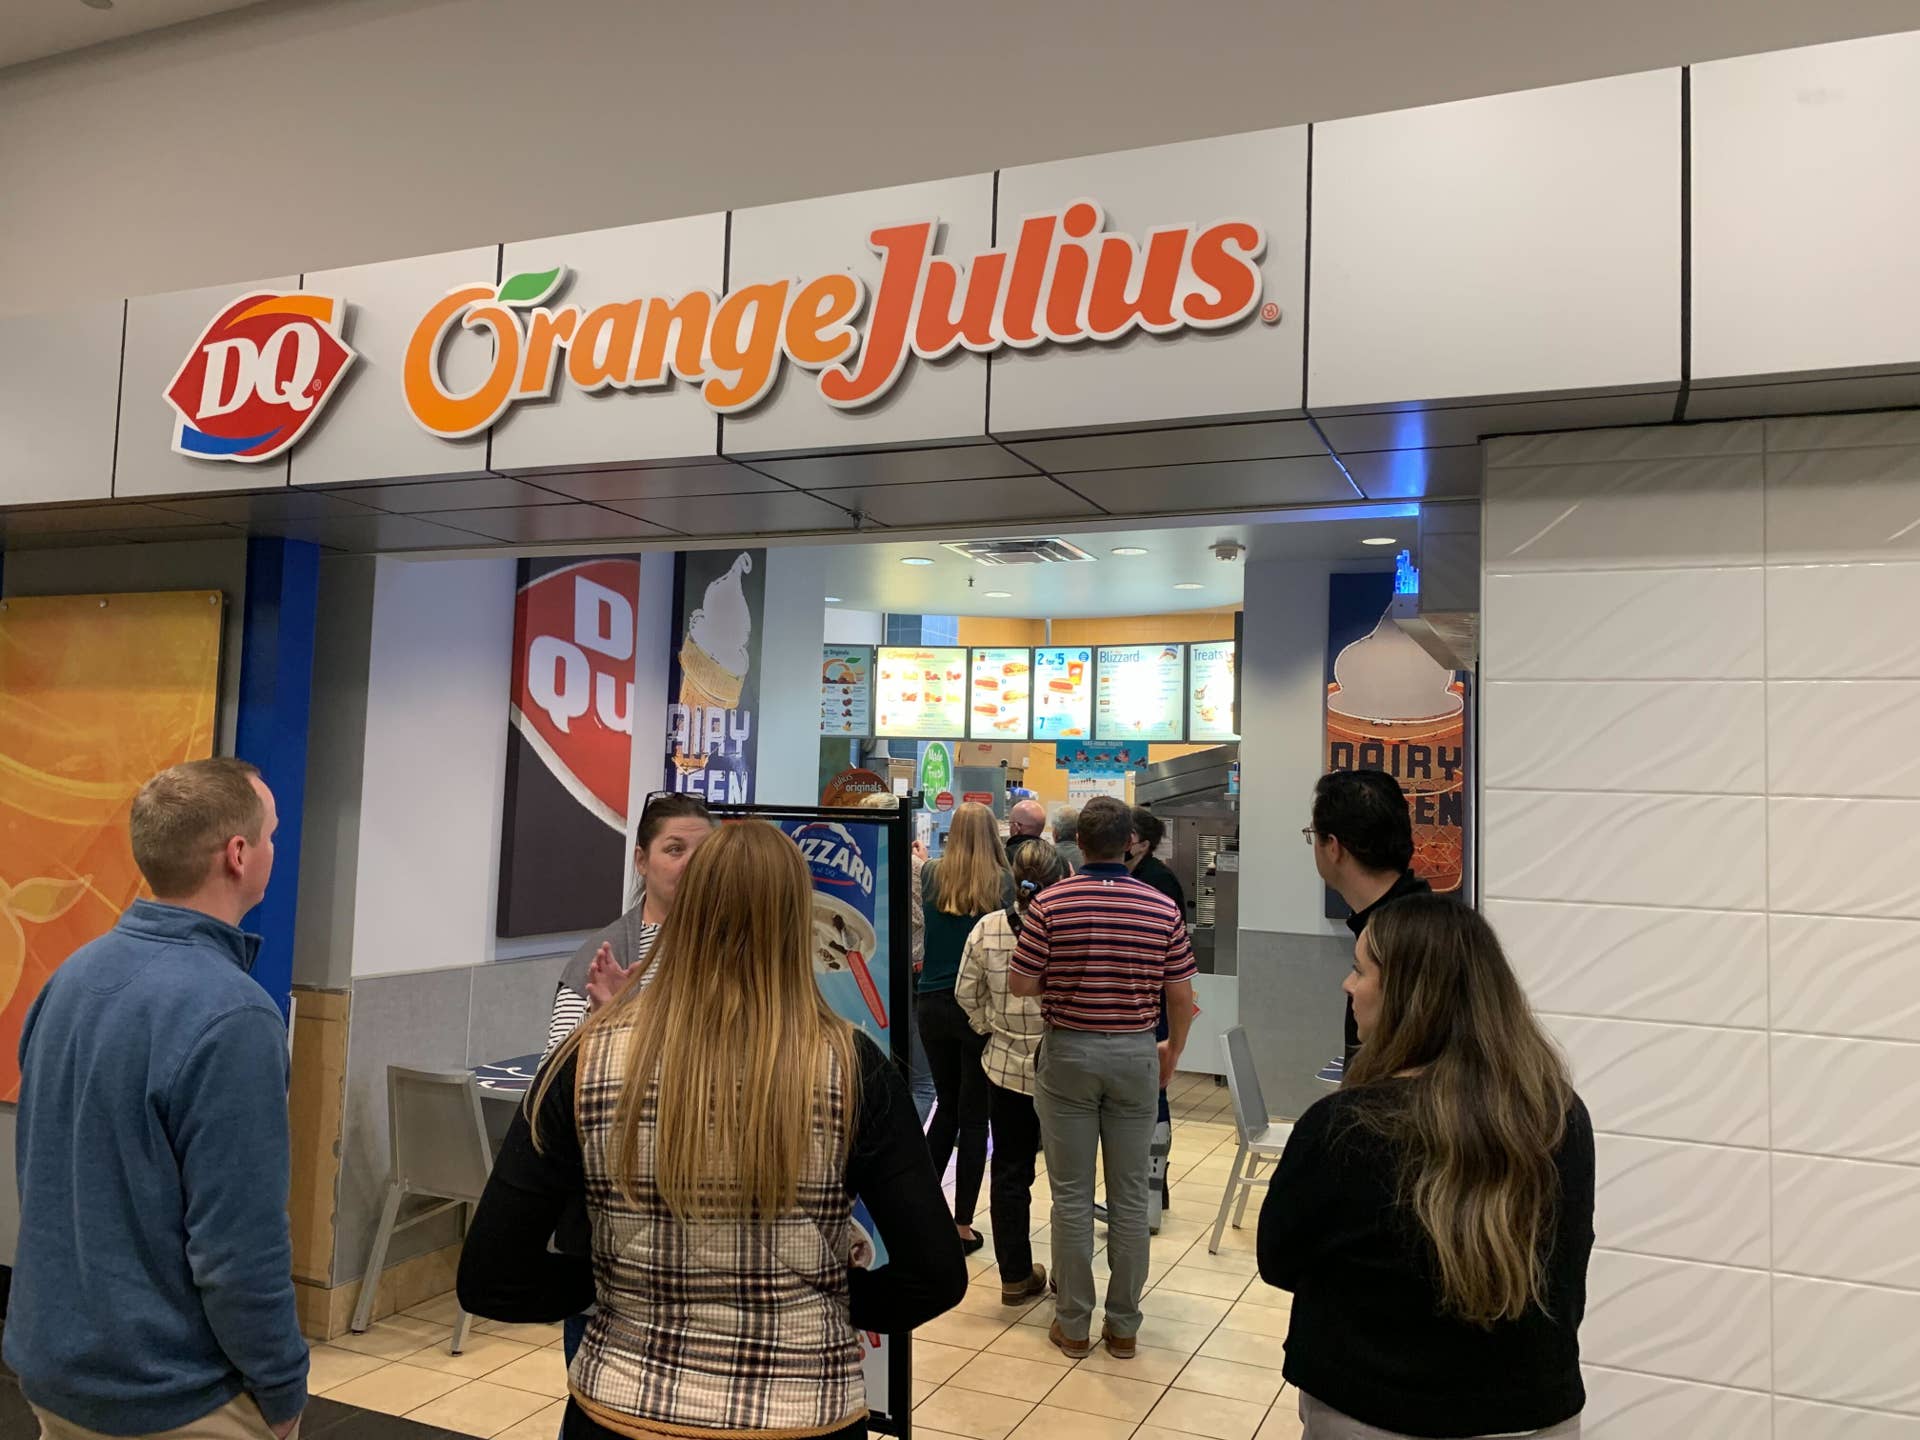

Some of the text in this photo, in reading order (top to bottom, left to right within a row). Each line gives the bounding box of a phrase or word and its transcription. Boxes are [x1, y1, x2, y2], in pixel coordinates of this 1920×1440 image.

[404, 203, 1259, 433] Orange Julius
[196, 322, 320, 420] DQ
[1037, 653, 1044, 665] 2
[1100, 650, 1140, 663] Blizzard
[1194, 649, 1223, 661] Treats
[667, 704, 750, 757] AIRY
[1331, 742, 1462, 781] DAIRY
[845, 781, 882, 793] originals
[800, 838, 873, 895] IZZARD
